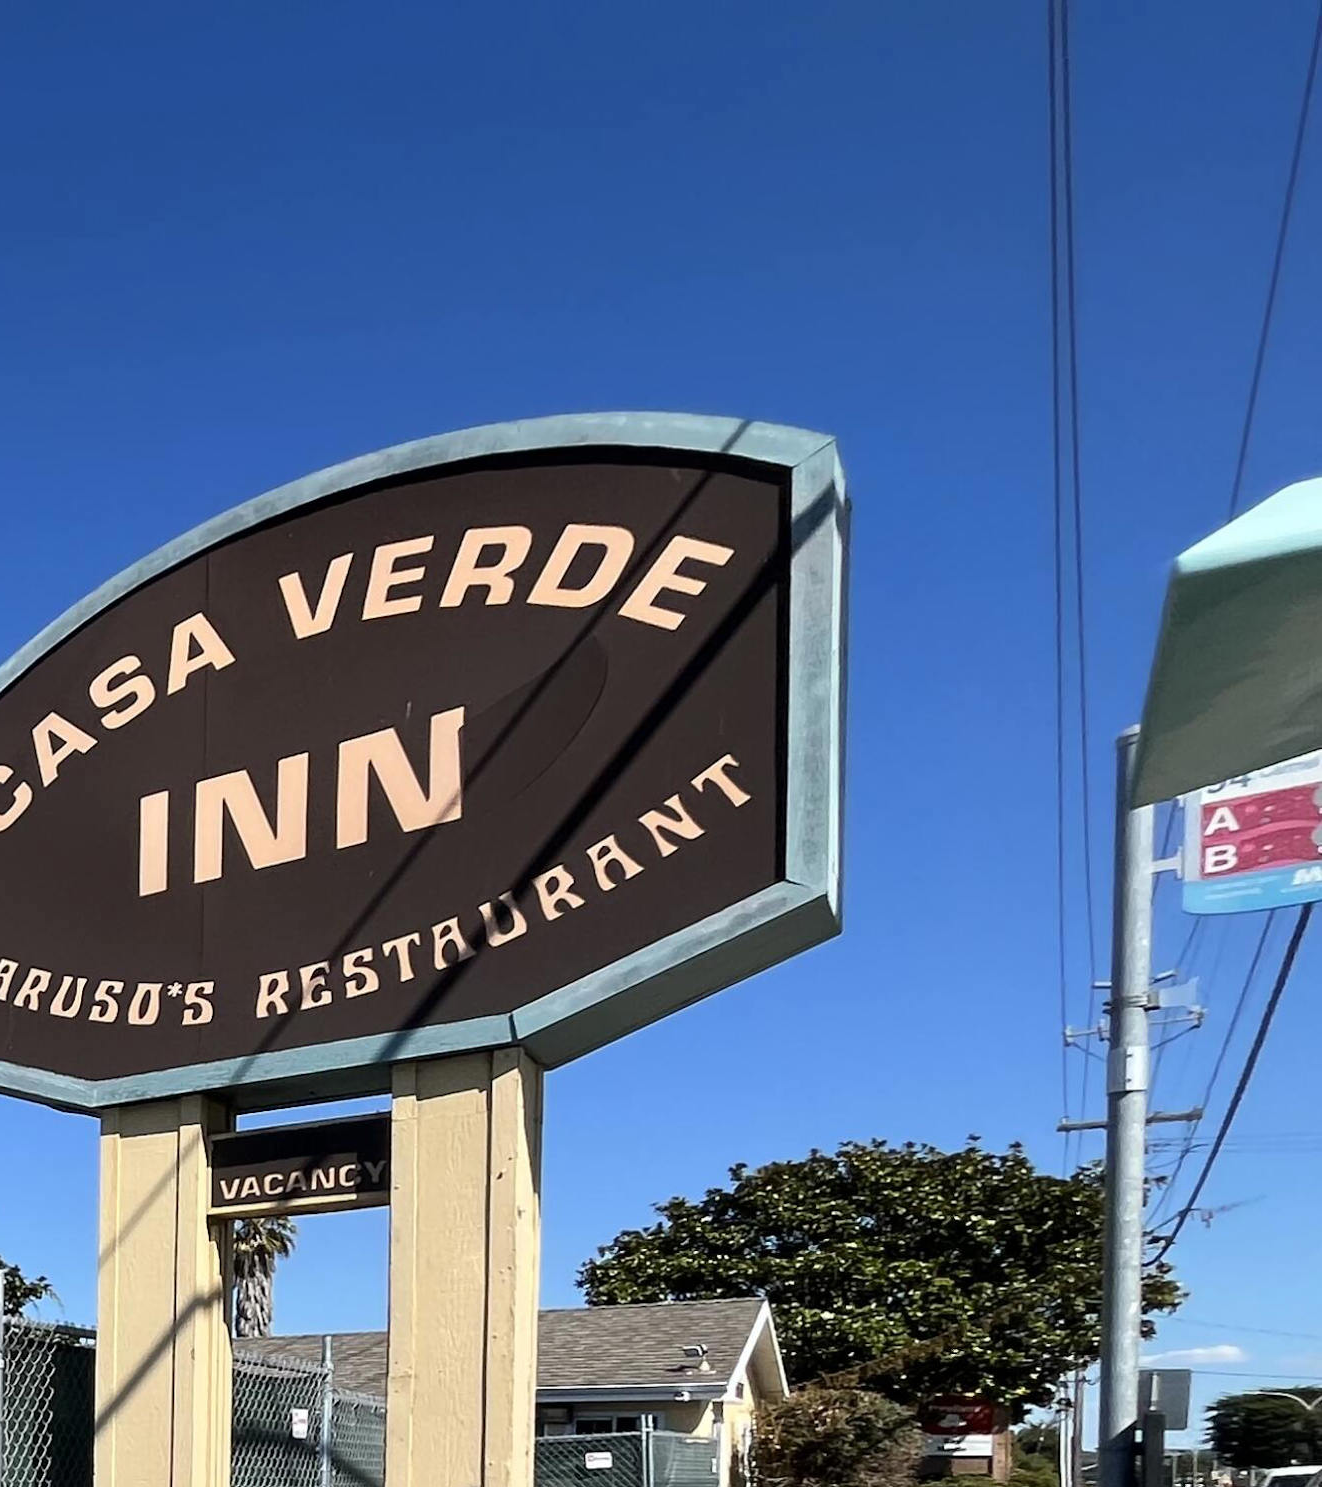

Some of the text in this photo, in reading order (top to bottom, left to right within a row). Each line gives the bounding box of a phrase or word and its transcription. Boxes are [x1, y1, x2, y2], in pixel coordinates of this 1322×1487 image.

[277, 523, 735, 640] VERDE
[138, 705, 466, 897] INN
[1203, 806, 1240, 836] A
[255, 753, 752, 1019] RESTAURANT
[1203, 844, 1238, 874] B
[219, 1161, 387, 1200] VACANCY
